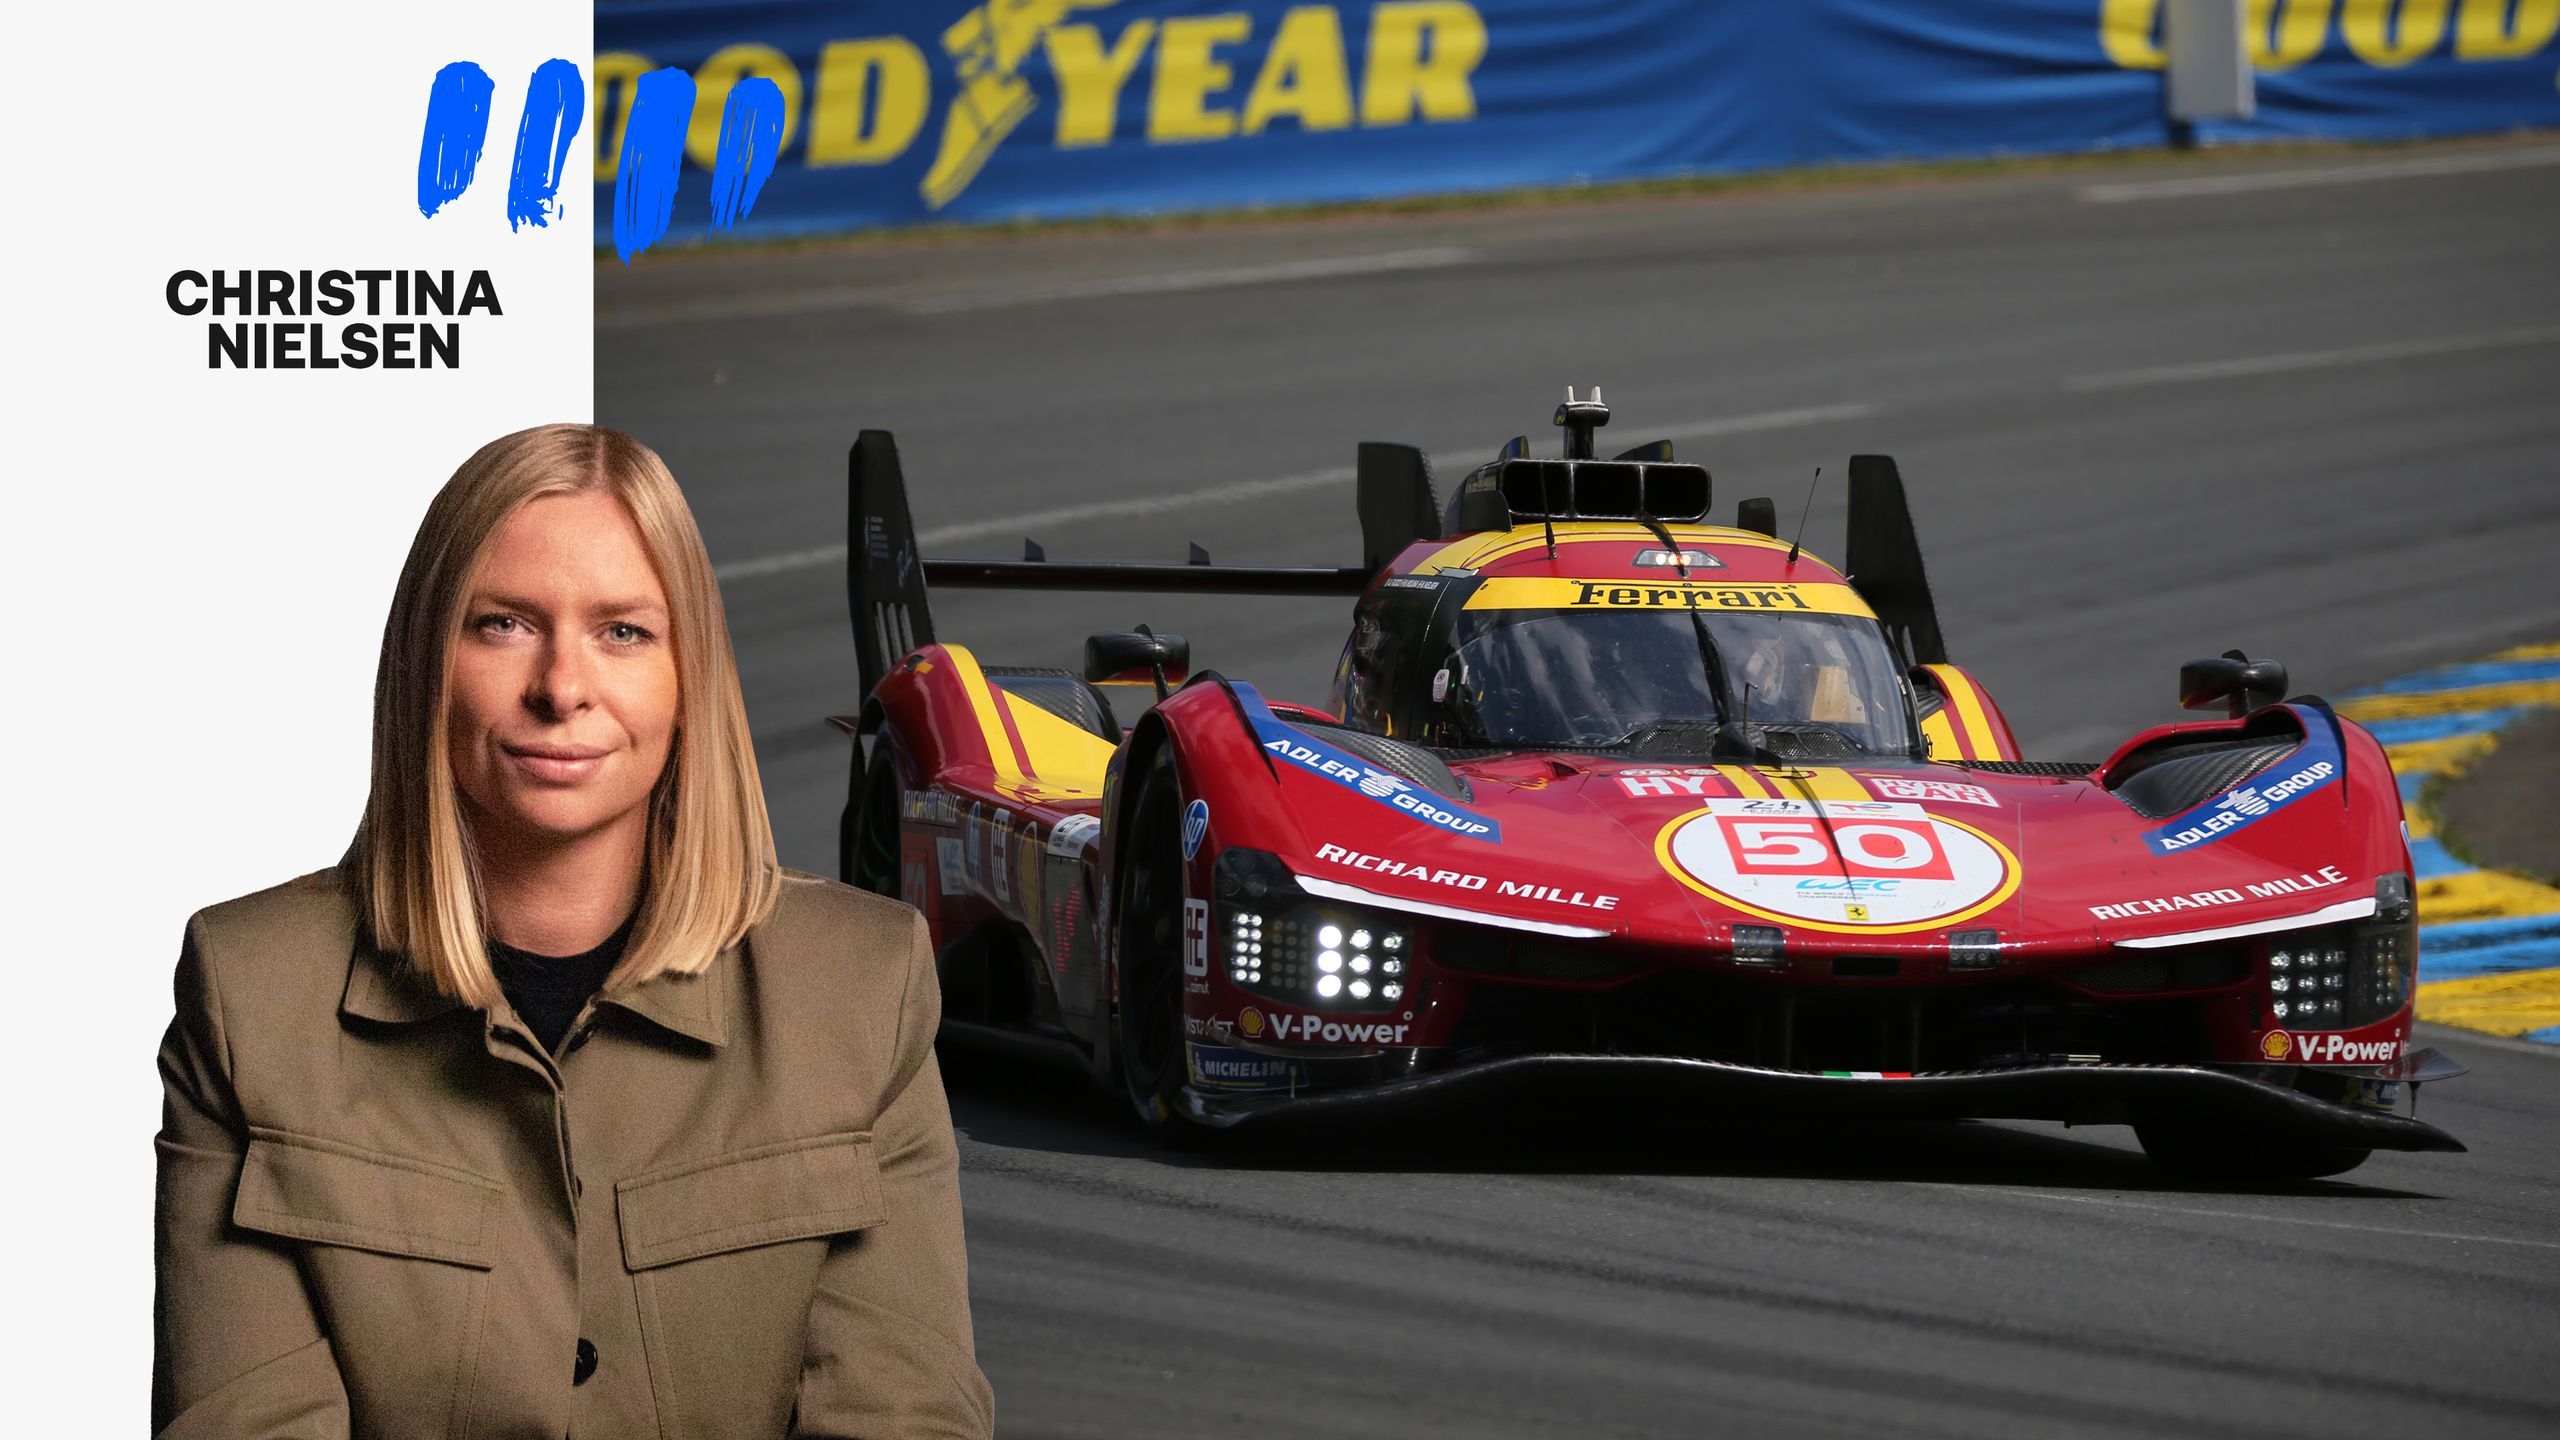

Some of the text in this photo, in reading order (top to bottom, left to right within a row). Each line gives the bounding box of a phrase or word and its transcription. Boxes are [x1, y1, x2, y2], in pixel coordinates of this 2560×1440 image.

[1044, 0, 1489, 148] YEAR
[1570, 581, 1812, 609] Ferrari
[1263, 738, 1490, 836] ADLER GROUP
[1620, 776, 1706, 796] HY
[1877, 779, 1982, 793] HYPER
[1886, 785, 1992, 804] CAR
[2159, 760, 2334, 850] ADLER GROUP
[1184, 801, 1205, 858] hp
[1731, 822, 1935, 870] 50
[1315, 842, 1620, 912] RICHARD MILLE
[1796, 879, 1902, 891] WEC
[2088, 865, 2349, 921] RICHARD MILLE
[1269, 1013, 1409, 1043] V-Power
[2297, 1033, 2398, 1062] V-Power
[1204, 1060, 1287, 1077] MICHELIN
